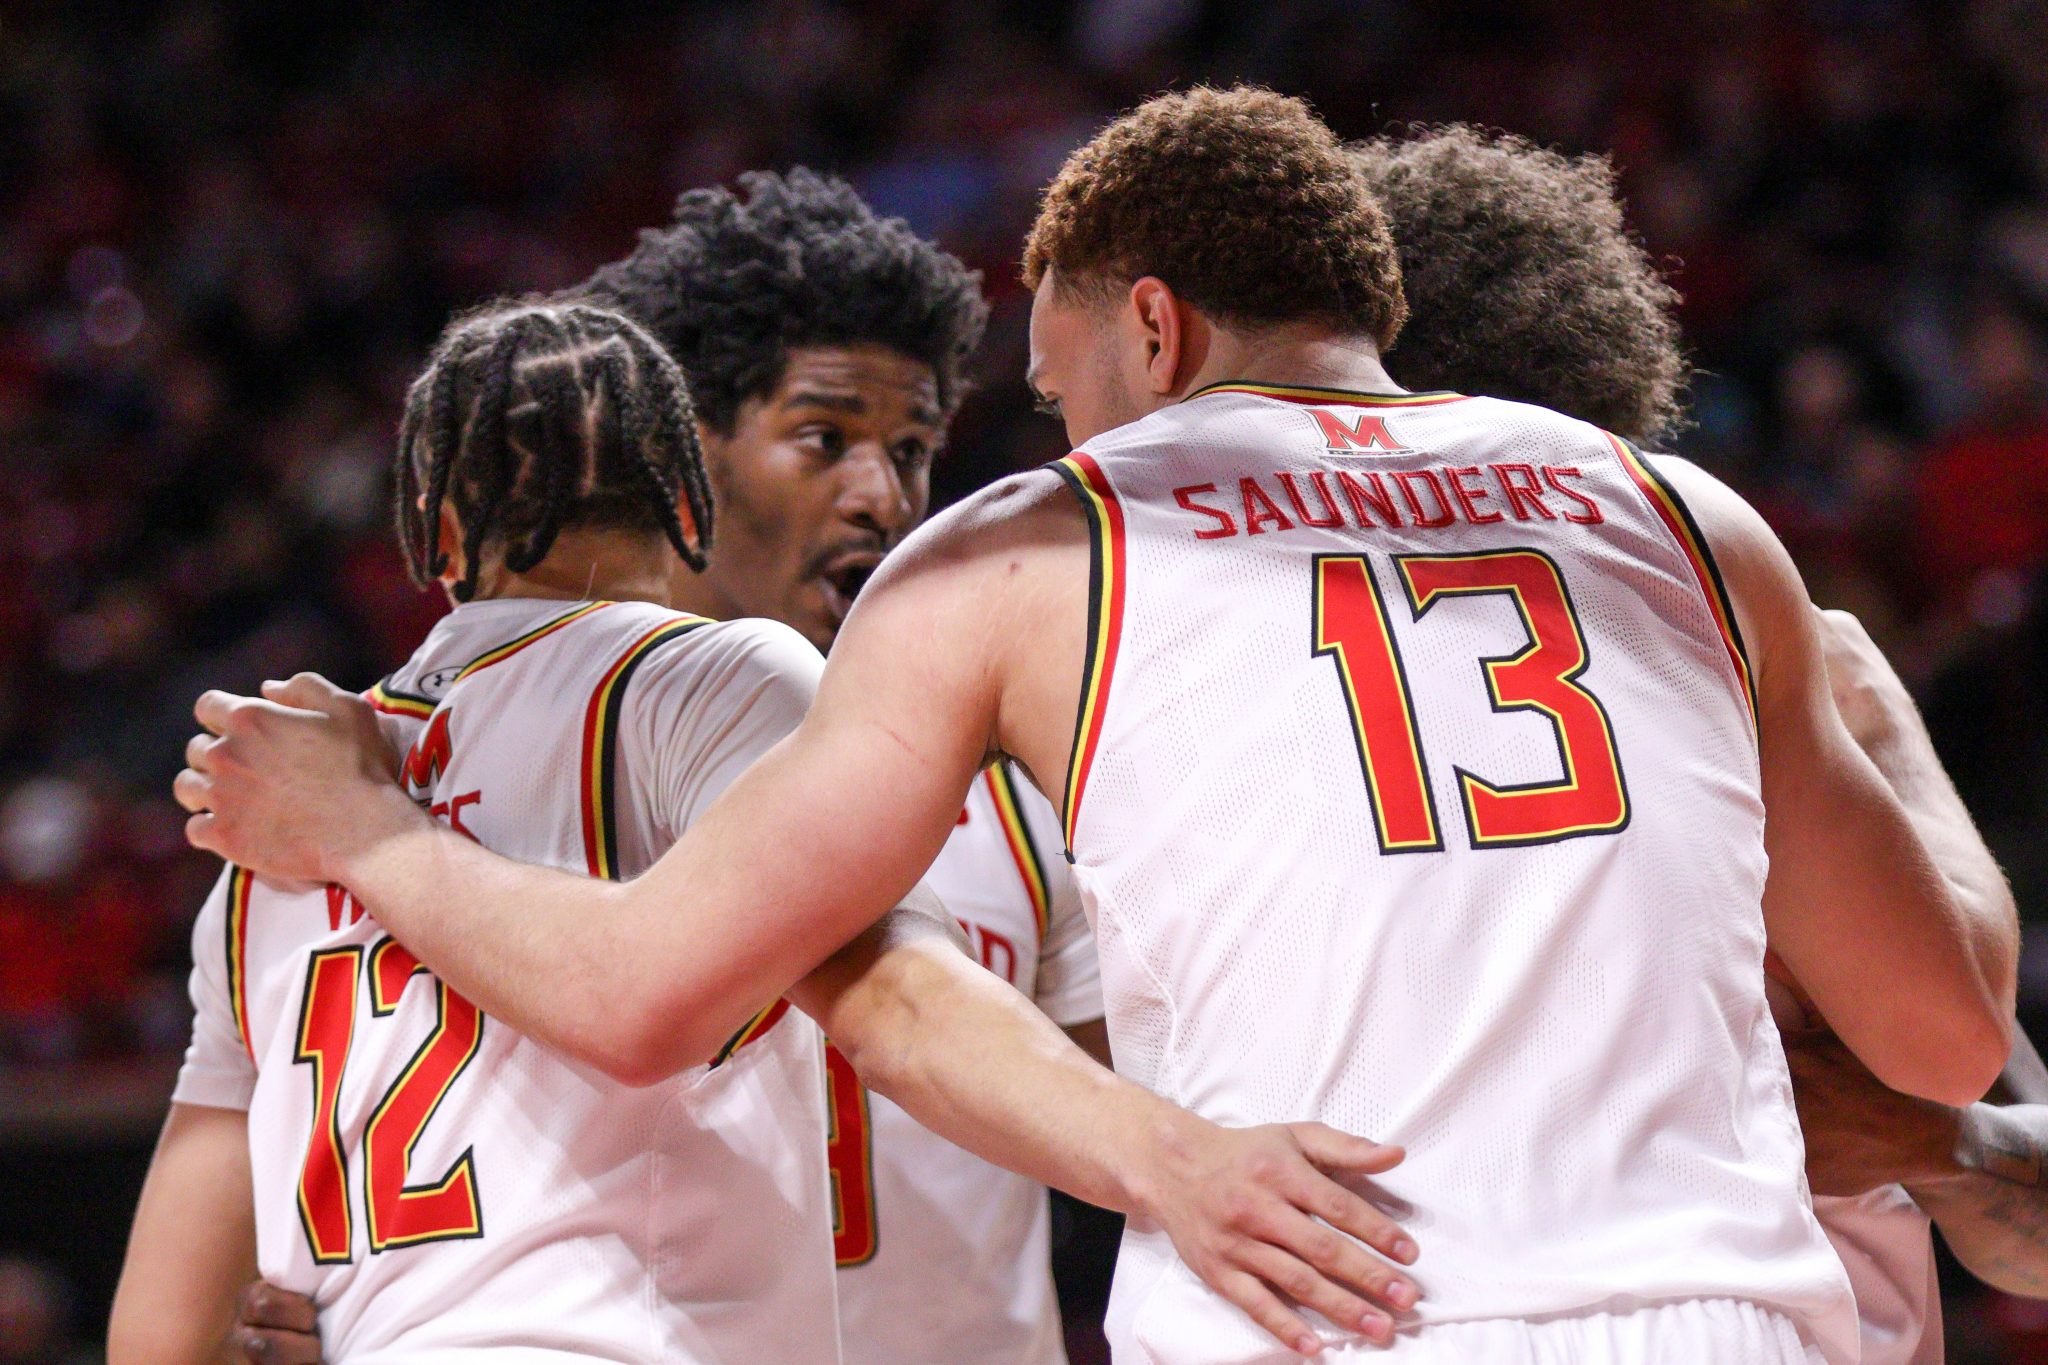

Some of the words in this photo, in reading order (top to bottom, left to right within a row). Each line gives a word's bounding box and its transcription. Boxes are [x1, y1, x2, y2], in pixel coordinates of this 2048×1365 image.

[1172, 463, 1605, 540] SAUNDERS
[1302, 408, 1411, 451] M
[1311, 546, 1631, 855] 13
[292, 934, 484, 1265] 12
